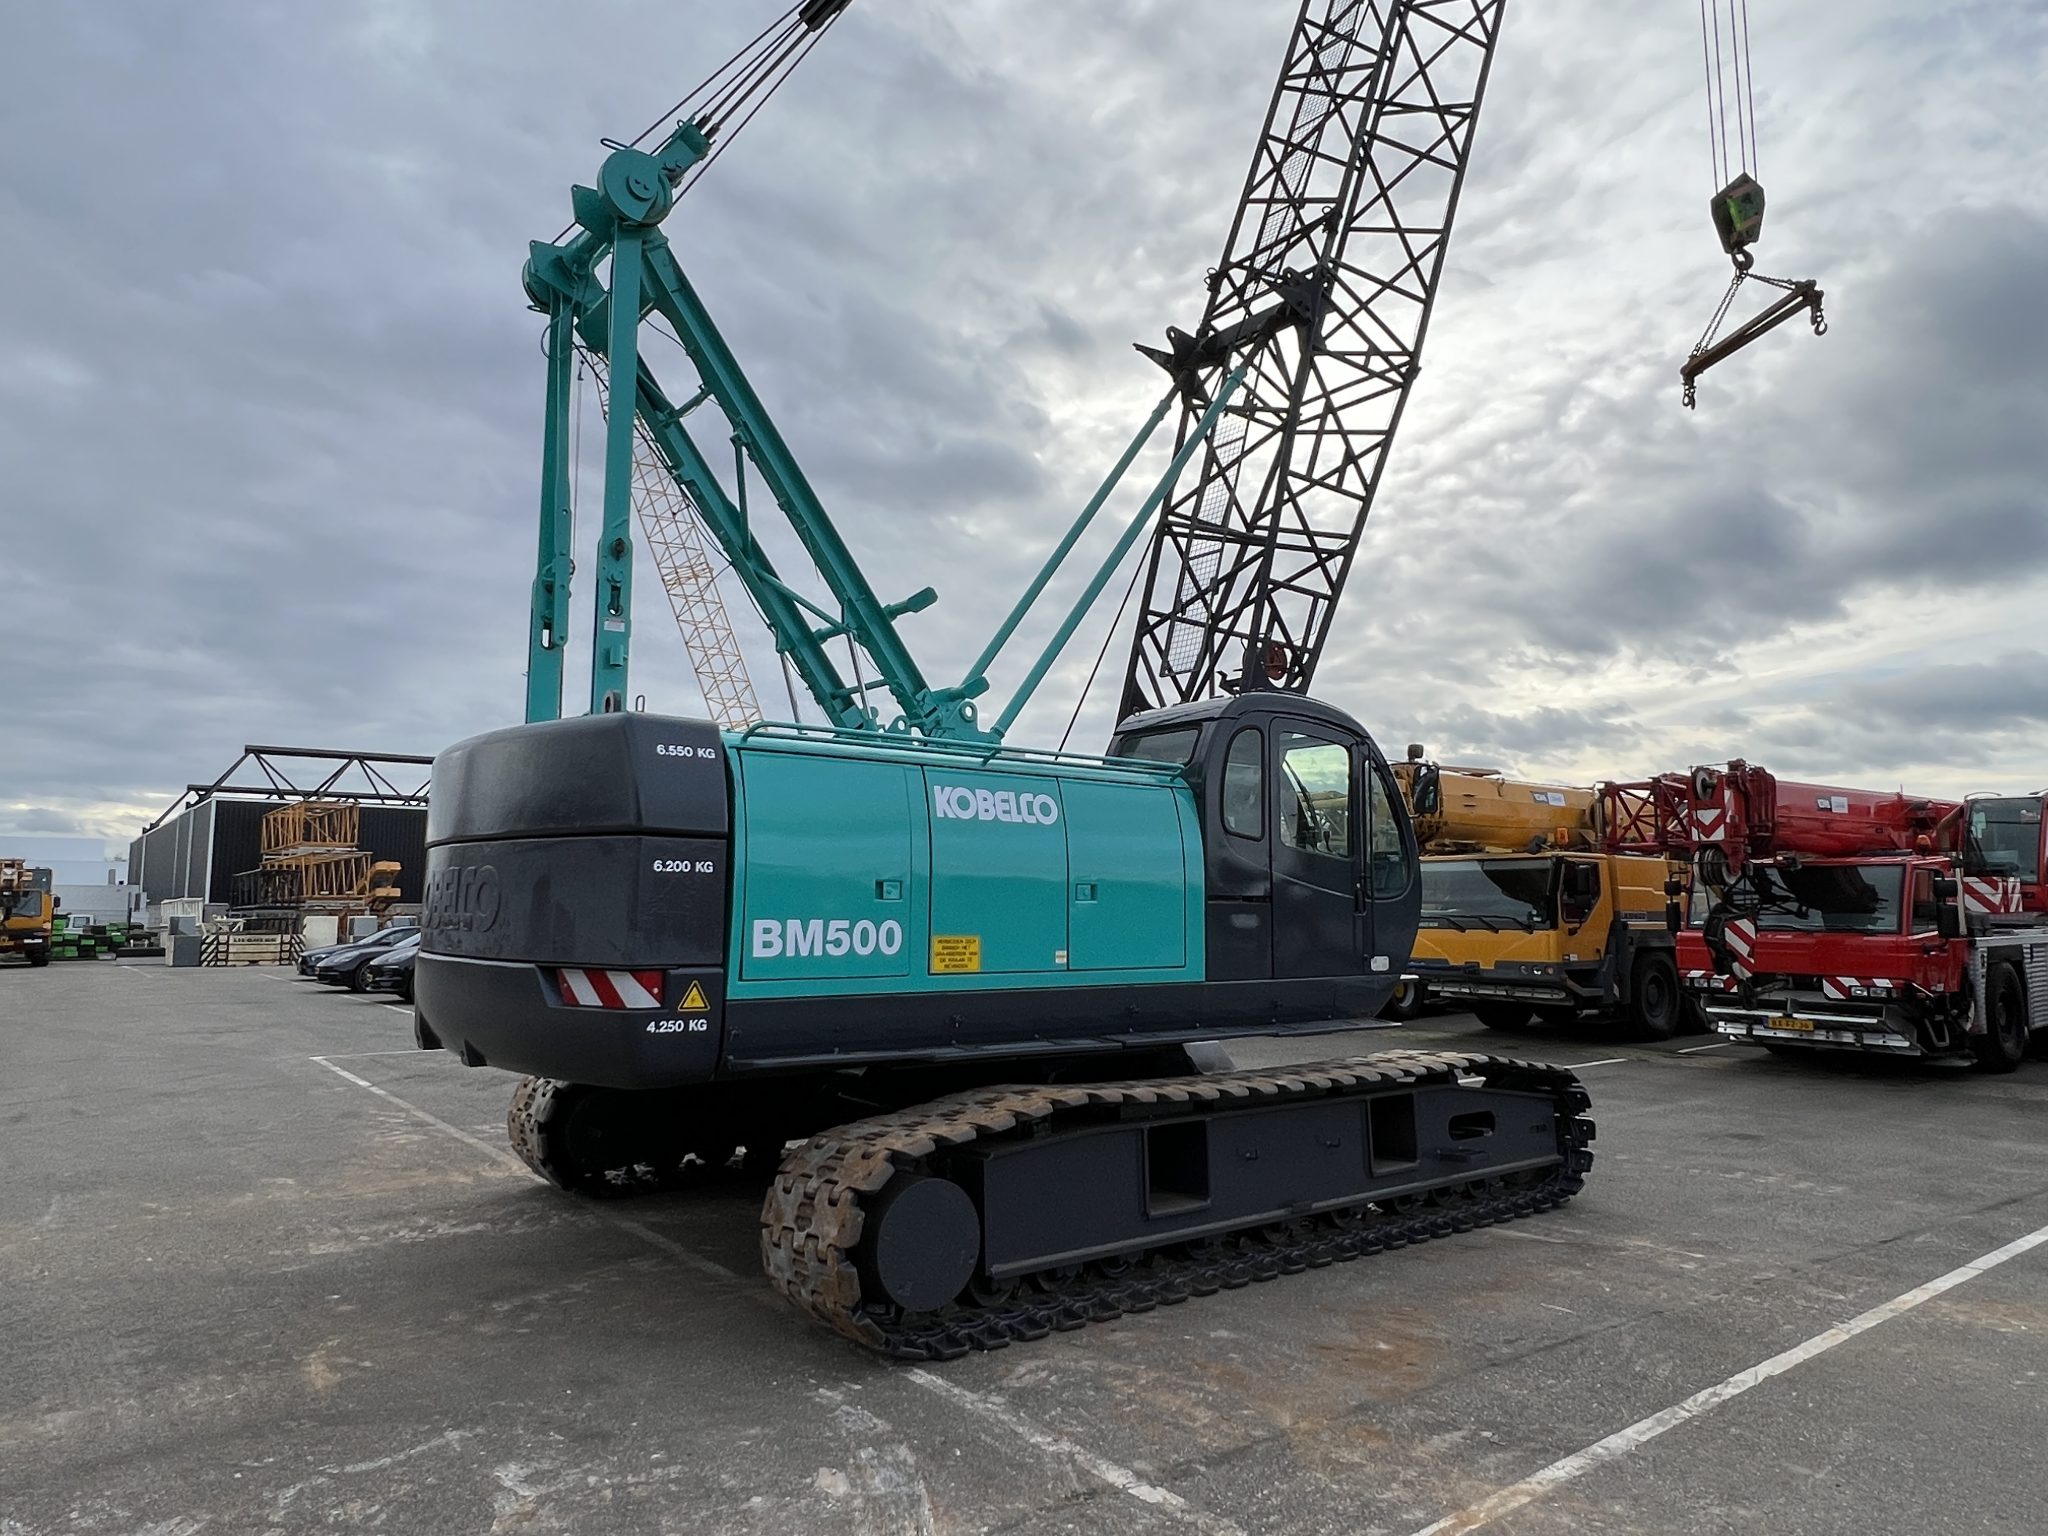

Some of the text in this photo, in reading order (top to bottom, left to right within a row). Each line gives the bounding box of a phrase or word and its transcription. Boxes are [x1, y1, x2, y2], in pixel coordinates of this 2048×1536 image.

[656, 744, 716, 759] 6.550 KG
[933, 785, 1058, 825] KOBELCO
[653, 860, 714, 873] 6.200 KG
[752, 919, 903, 957] BM500
[646, 1019, 708, 1033] 4.250 KG
